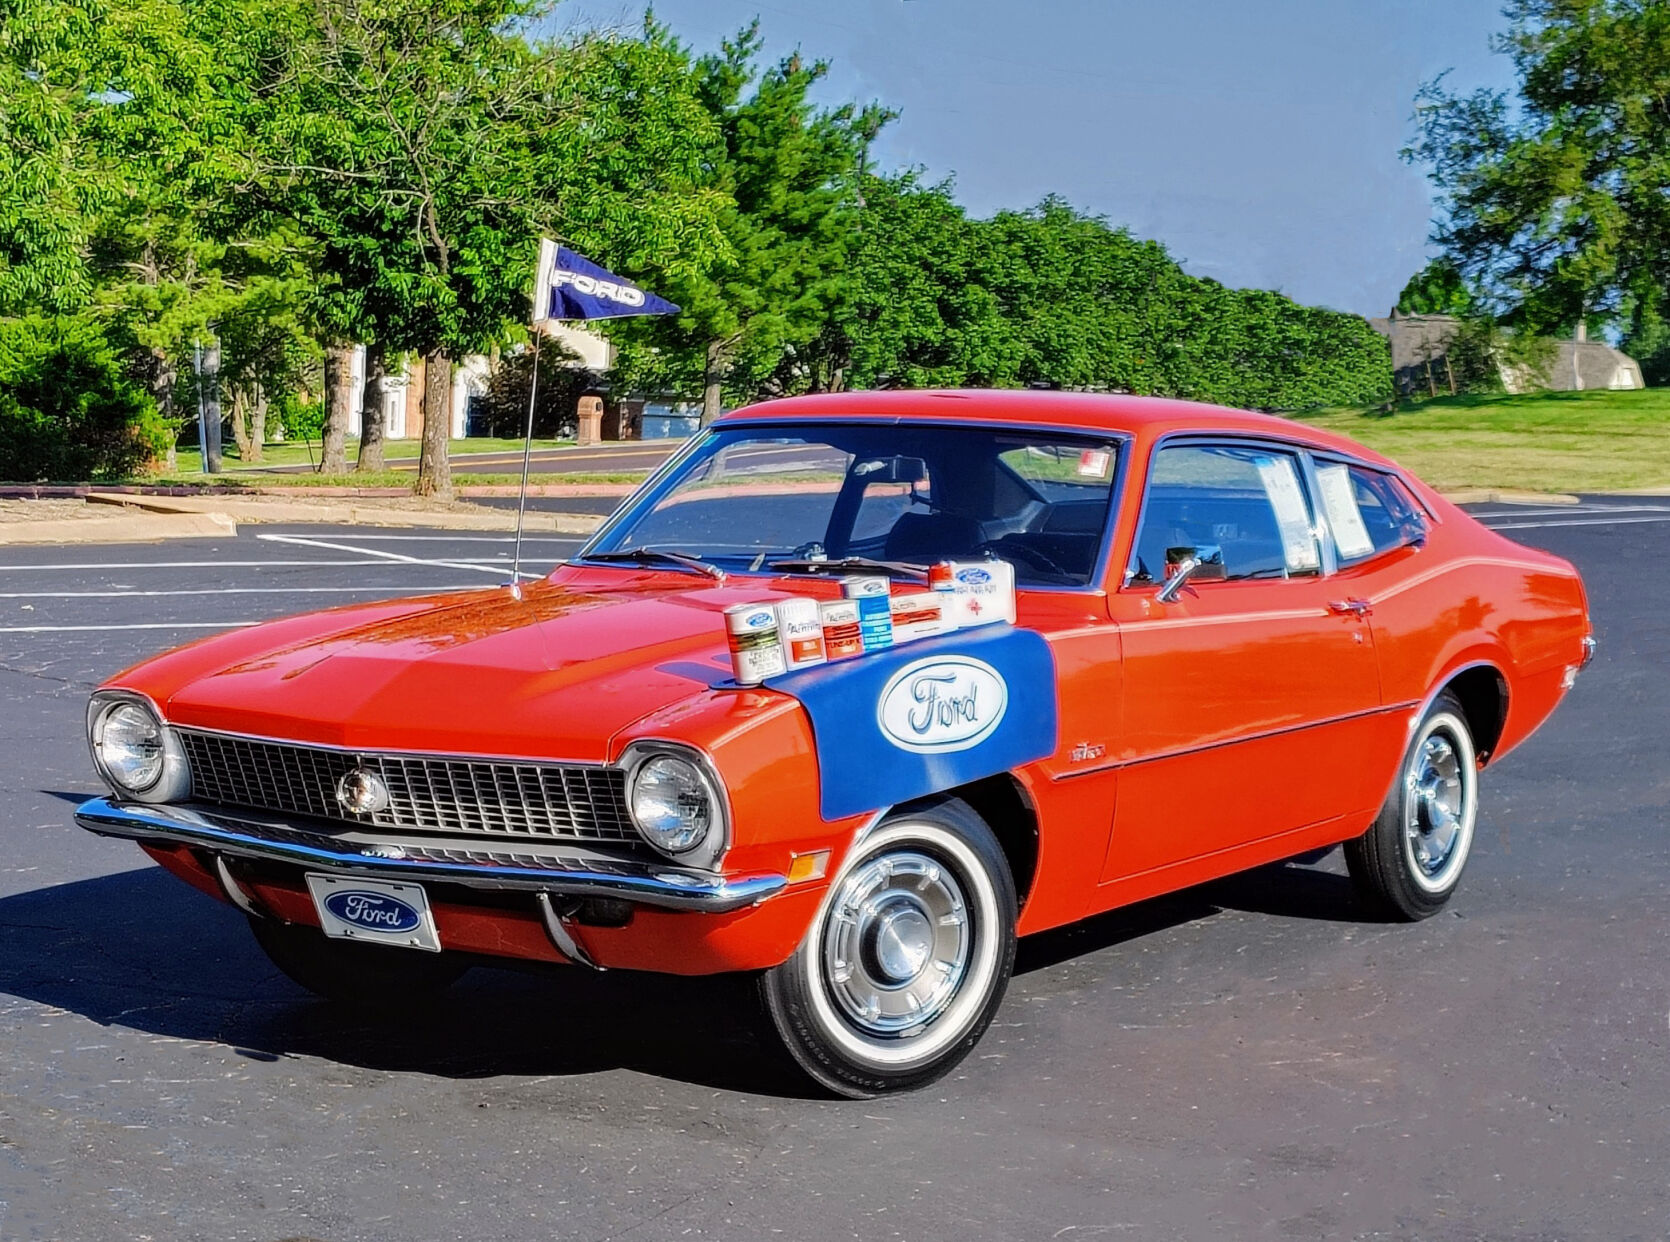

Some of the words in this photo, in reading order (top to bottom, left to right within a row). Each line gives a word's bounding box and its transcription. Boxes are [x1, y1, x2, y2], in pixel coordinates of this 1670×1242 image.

[551, 269, 646, 307] FORD
[908, 672, 978, 735] Ford
[345, 895, 402, 926] Ford
